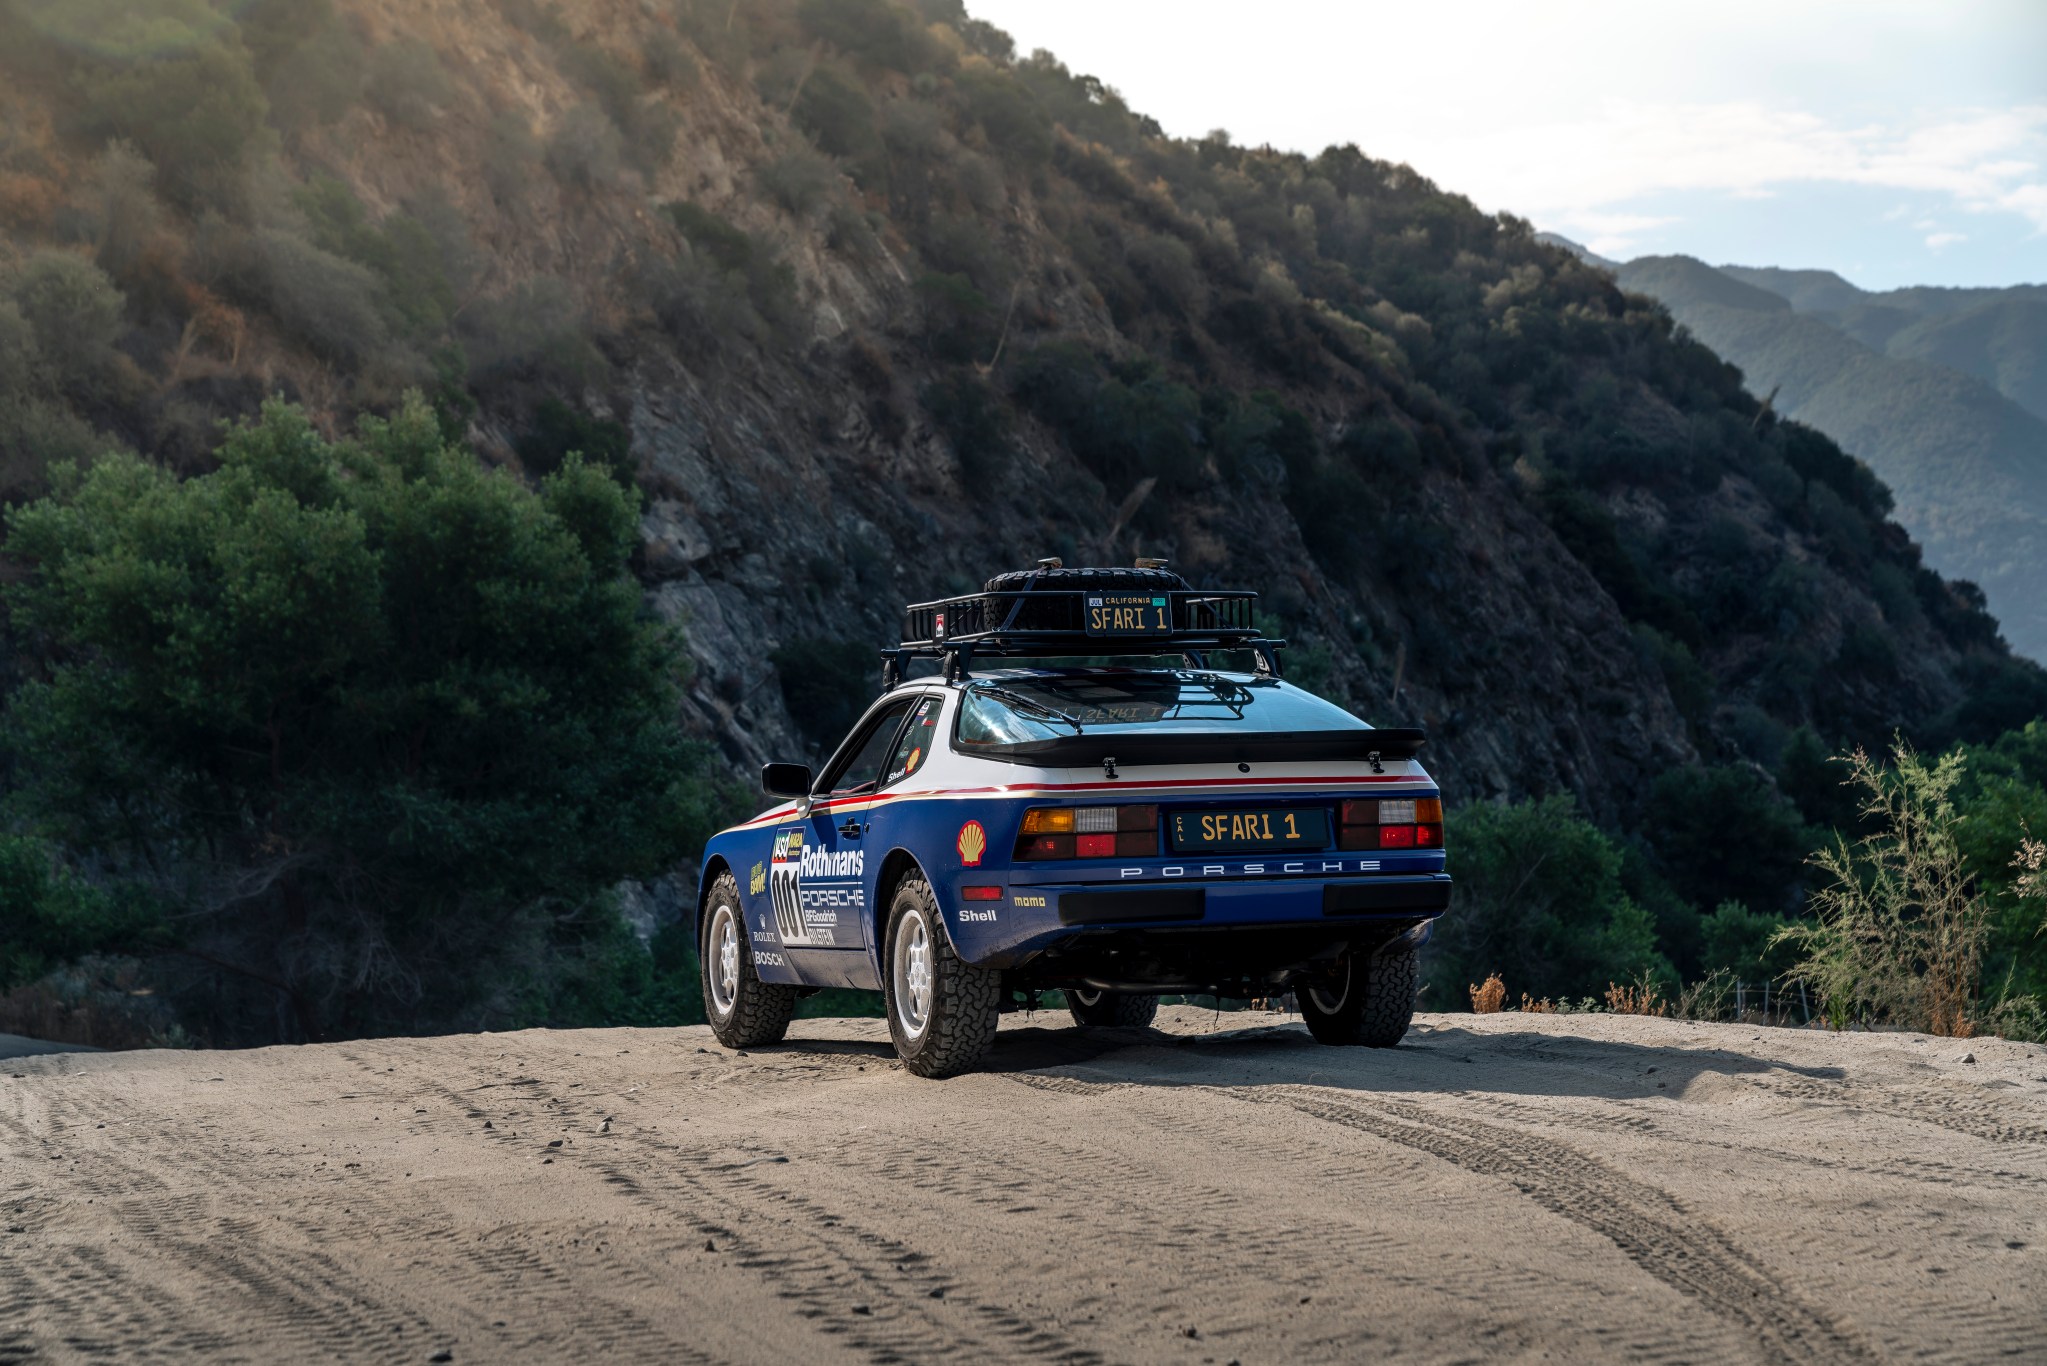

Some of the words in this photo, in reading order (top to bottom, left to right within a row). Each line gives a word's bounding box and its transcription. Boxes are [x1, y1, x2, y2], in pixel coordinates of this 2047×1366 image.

[1105, 597, 1151, 605] CALIFORNIA
[1091, 607, 1146, 630] SFARI
[1156, 607, 1167, 630] 1
[887, 767, 906, 782] Shell
[1201, 814, 1274, 841] SFARI
[1284, 813, 1301, 839] 1
[800, 843, 864, 878] Rothmans
[1120, 860, 1381, 878] PORSCHE
[771, 869, 808, 938] 001
[800, 889, 865, 907] PORSCHE
[804, 909, 838, 922] BFGoodrich
[958, 909, 997, 922] Shell
[753, 931, 776, 943] ROLEX
[754, 950, 785, 967] BOSCH
